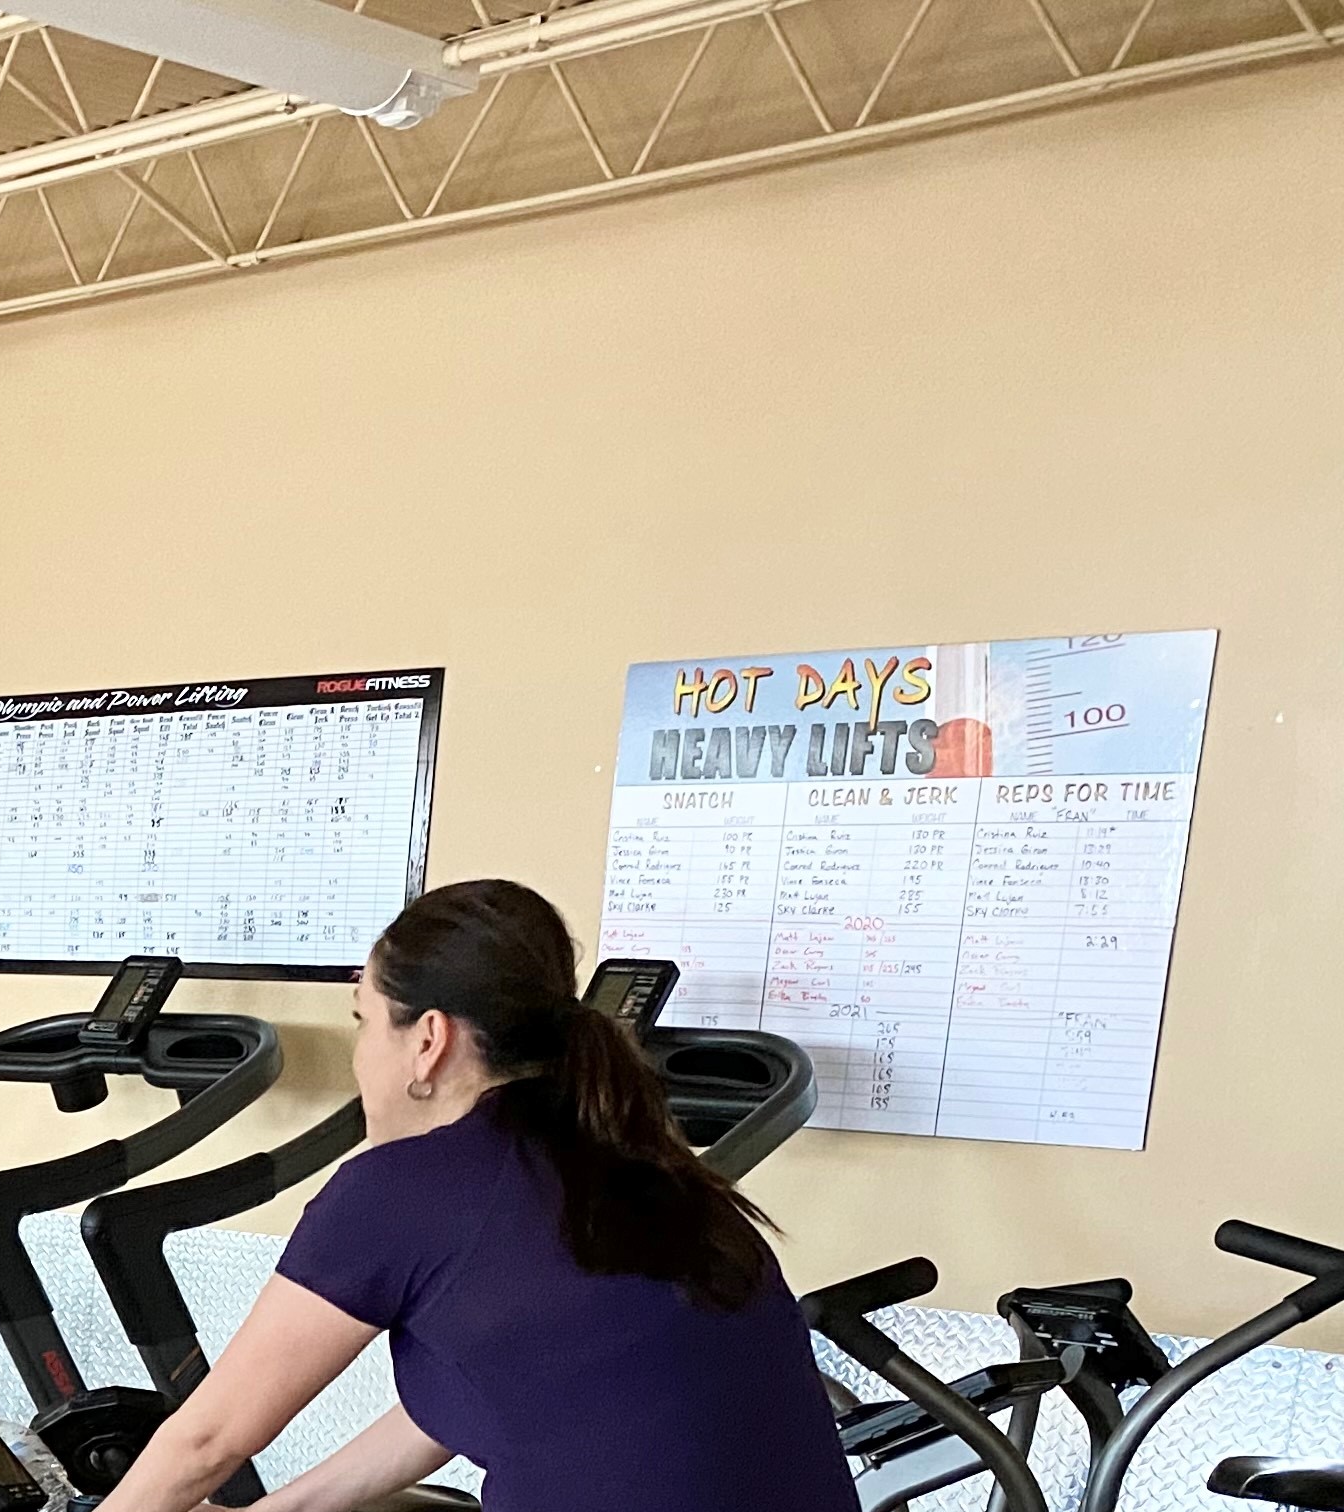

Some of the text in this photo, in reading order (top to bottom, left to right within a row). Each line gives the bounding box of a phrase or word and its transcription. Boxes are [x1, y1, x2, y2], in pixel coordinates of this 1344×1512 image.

[317, 674, 431, 693] ROGUEFITNESS
[66, 692, 109, 711] and
[107, 690, 173, 710] Power
[175, 684, 249, 708] Lifting
[673, 656, 932, 730] HOT DAYS
[1064, 703, 1126, 729] 100
[649, 717, 939, 780] HEAVY LIFTS
[663, 791, 734, 809] SNATCH
[808, 785, 958, 806] CLEAN & JERK
[996, 781, 1176, 804] REPS FOR TIME
[723, 832, 738, 841] 100
[932, 830, 945, 840] PR
[931, 845, 944, 855] PR
[931, 861, 943, 870] PR
[714, 888, 733, 898] 230
[714, 902, 732, 912] 125
[898, 903, 923, 915] 155
[844, 916, 885, 930] 2020
[1086, 936, 1117, 950] 2:29
[829, 1004, 867, 1020] 2021
